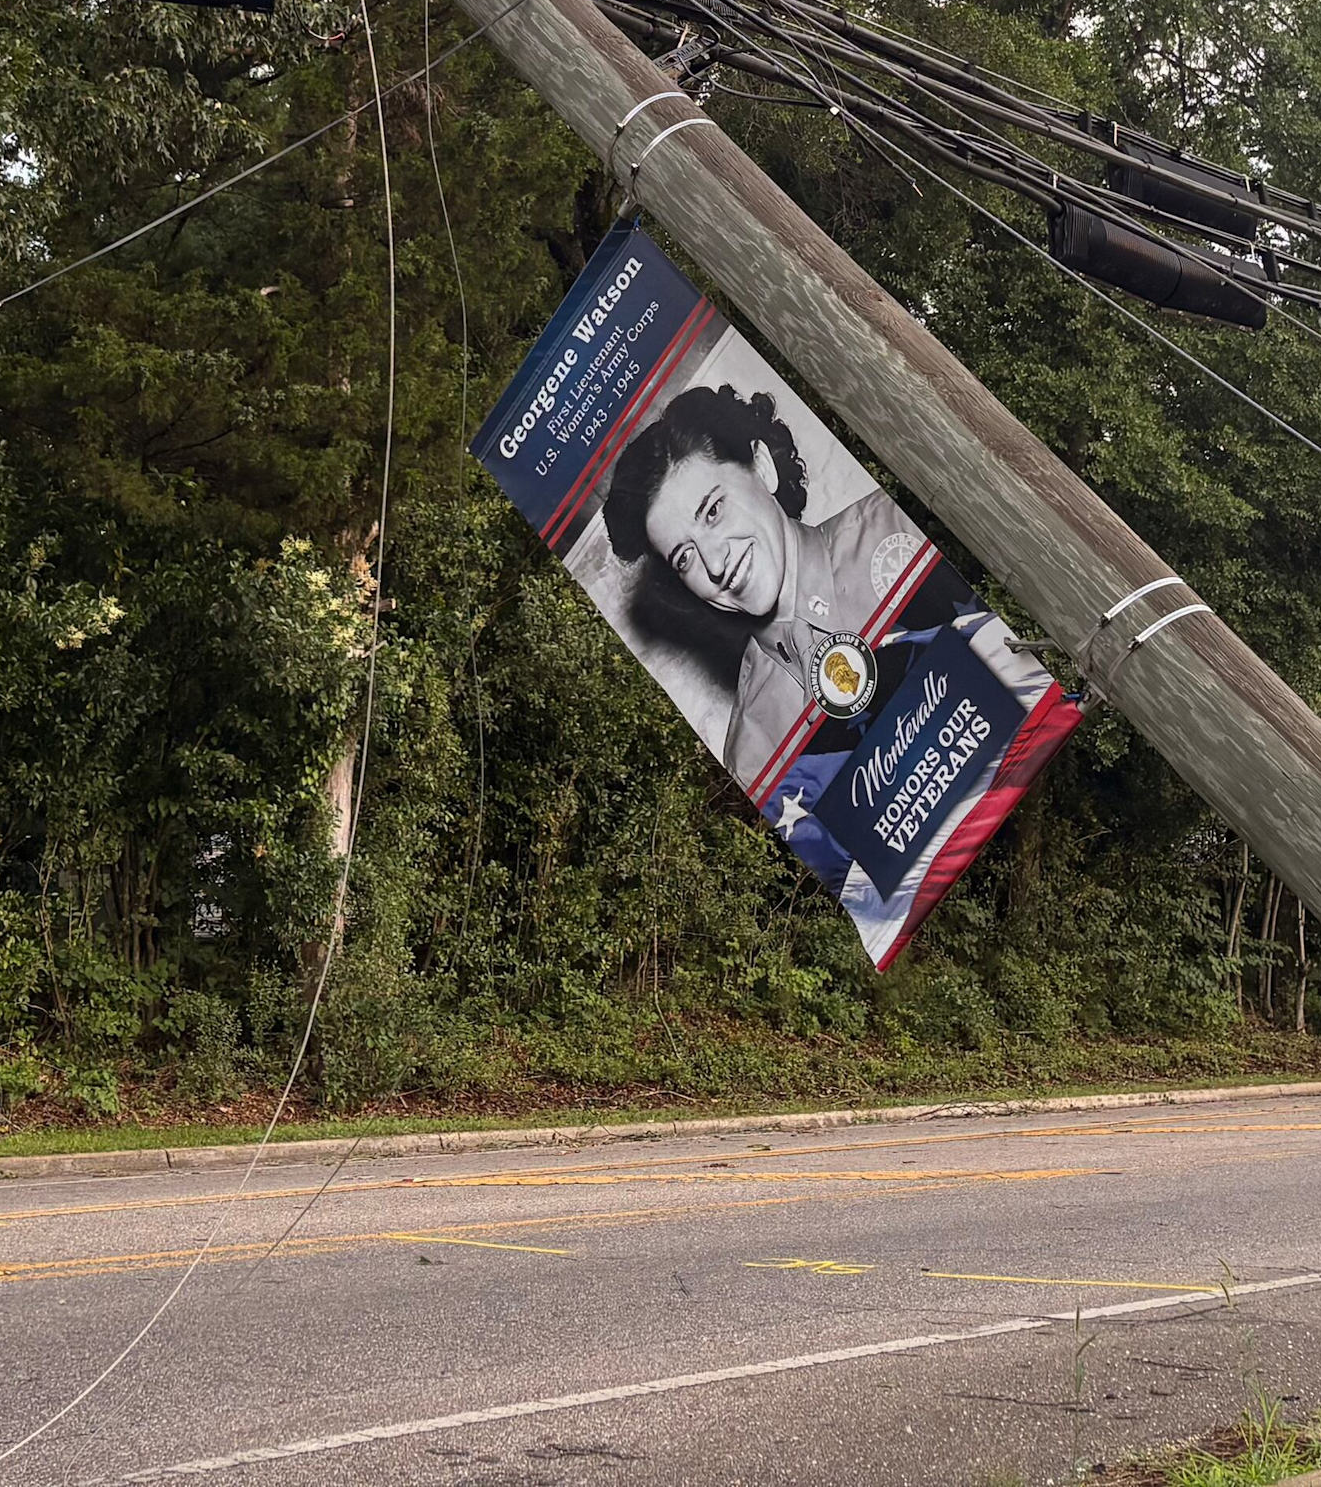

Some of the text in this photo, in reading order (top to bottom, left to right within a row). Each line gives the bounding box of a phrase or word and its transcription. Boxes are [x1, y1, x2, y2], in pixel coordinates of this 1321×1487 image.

[499, 257, 643, 459] Georgene Watson
[535, 300, 660, 476] U.S. Women's Army Corps
[547, 325, 625, 435] First Lieutenant
[580, 409, 608, 448] 1943
[612, 360, 641, 399] 1945
[810, 633, 860, 700] WOMEN'S ARMY CORPS
[849, 679, 874, 714] VETERAN
[851, 670, 948, 807] Montevallo
[873, 698, 978, 841] HONORS OUR
[886, 714, 991, 854] VETERANS
